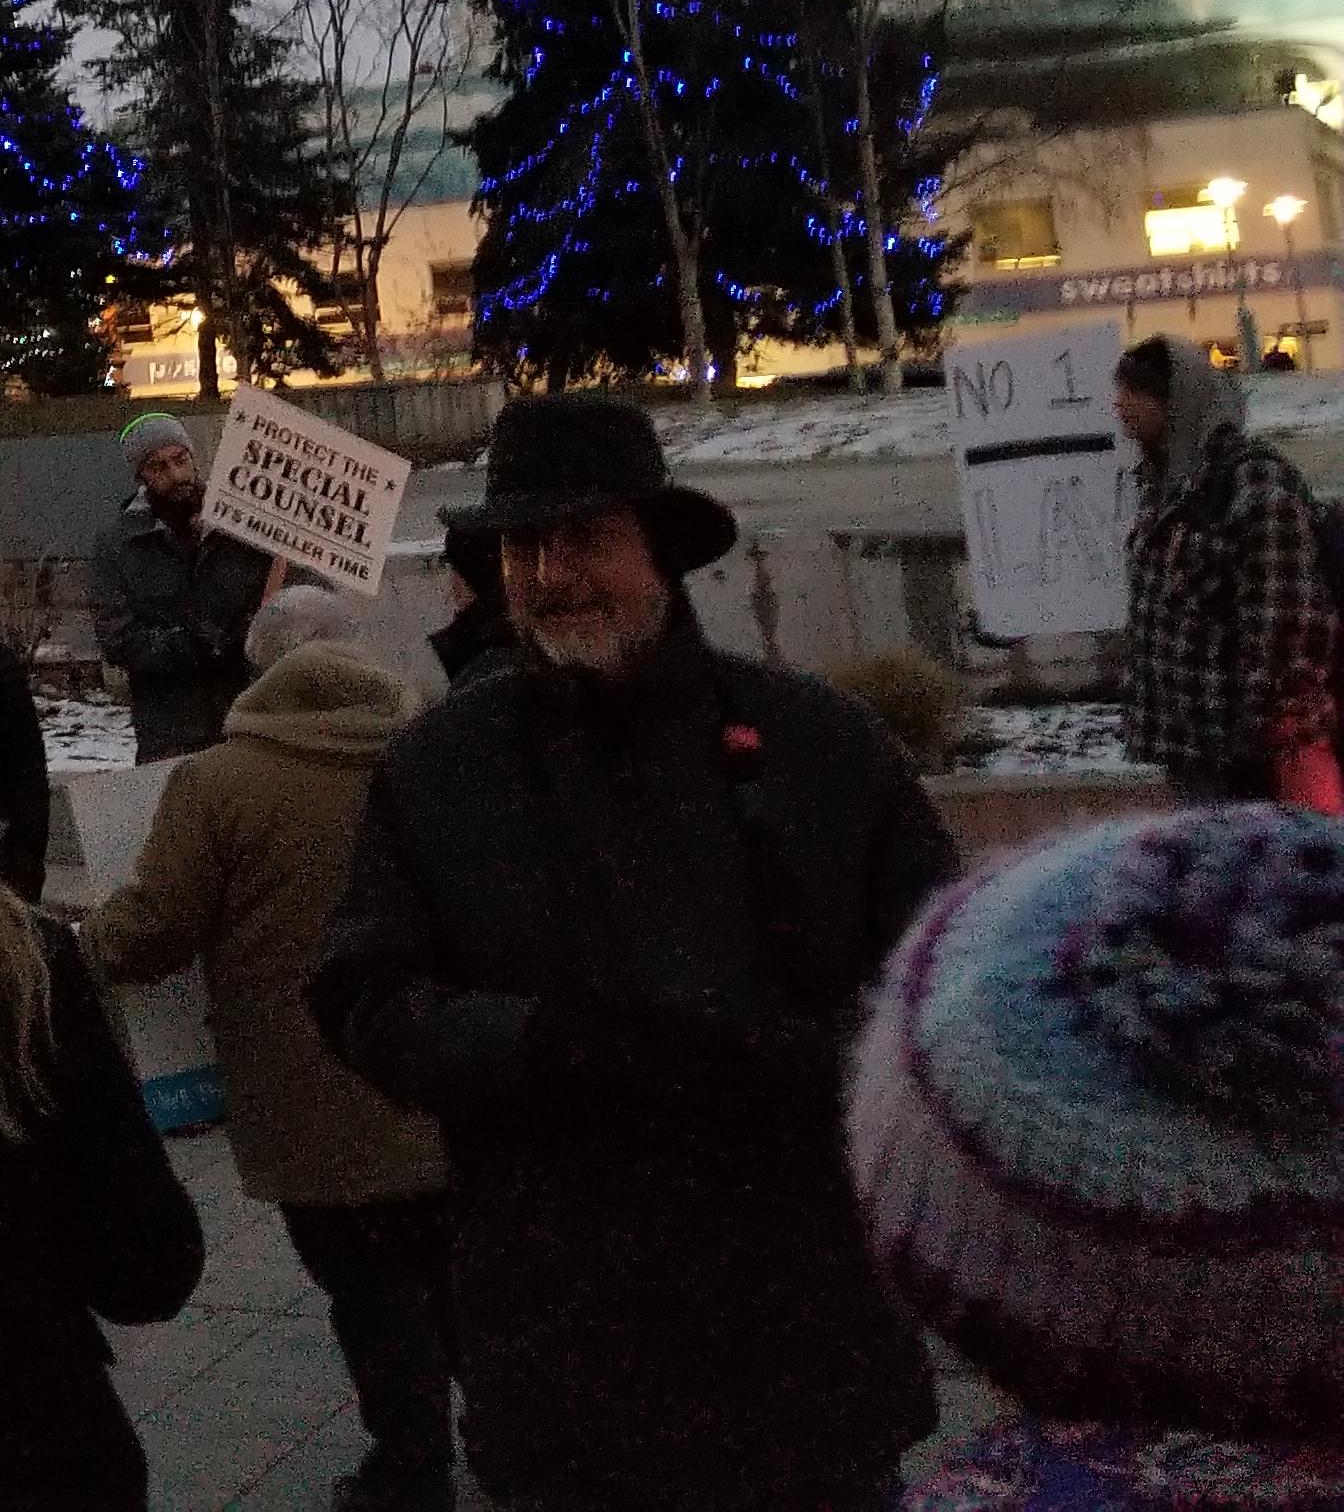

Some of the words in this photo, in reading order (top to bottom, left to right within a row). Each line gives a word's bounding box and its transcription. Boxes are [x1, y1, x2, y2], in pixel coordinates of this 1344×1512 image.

[953, 359, 1014, 418] NO
[243, 439, 370, 516] SPECIAL
[252, 414, 340, 468] PROTECT
[343, 455, 379, 486] THE
[229, 465, 372, 550] COUNSEL
[247, 515, 325, 561] MUELLER
[329, 551, 370, 581] TIME
